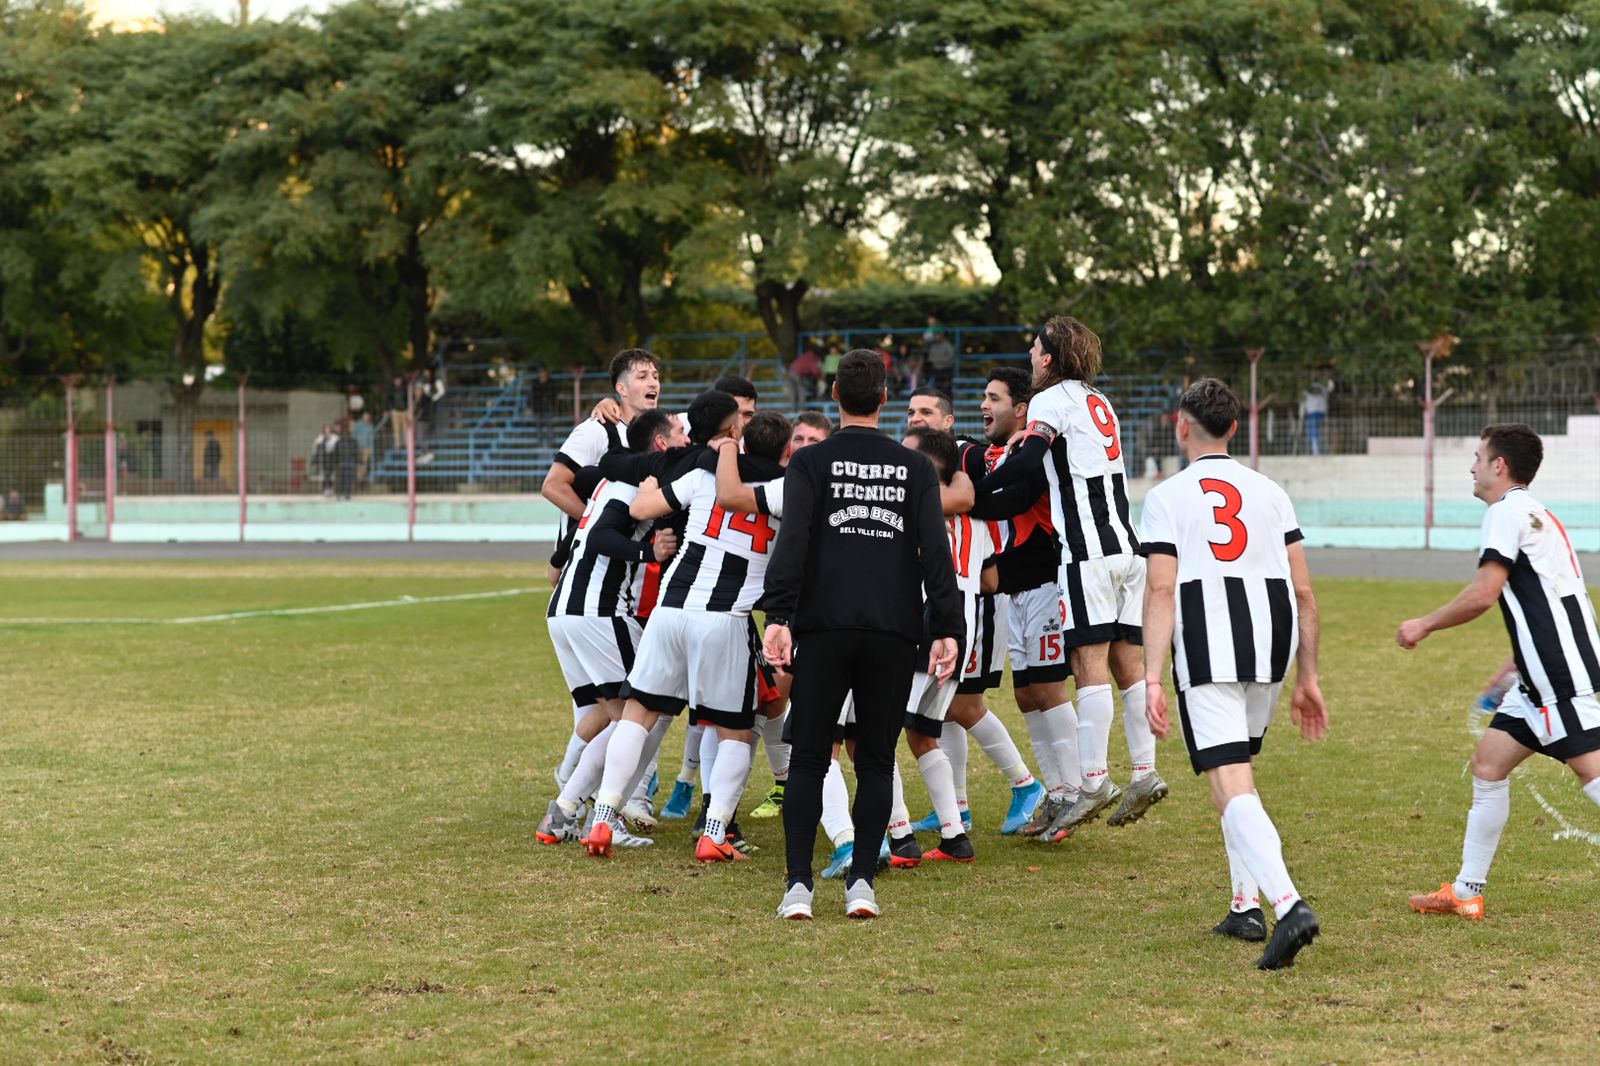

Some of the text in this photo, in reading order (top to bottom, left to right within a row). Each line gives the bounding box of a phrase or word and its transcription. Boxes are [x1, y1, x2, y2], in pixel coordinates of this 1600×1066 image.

[1086, 394, 1120, 461] 9
[831, 461, 908, 480] CUERPO
[830, 482, 906, 502] TECNICO
[702, 496, 776, 555] 14
[828, 505, 904, 532] CLUB BELL
[1199, 477, 1248, 562] 3
[839, 526, 894, 539] BELL VILLE (CBA)
[1039, 633, 1062, 661] 15
